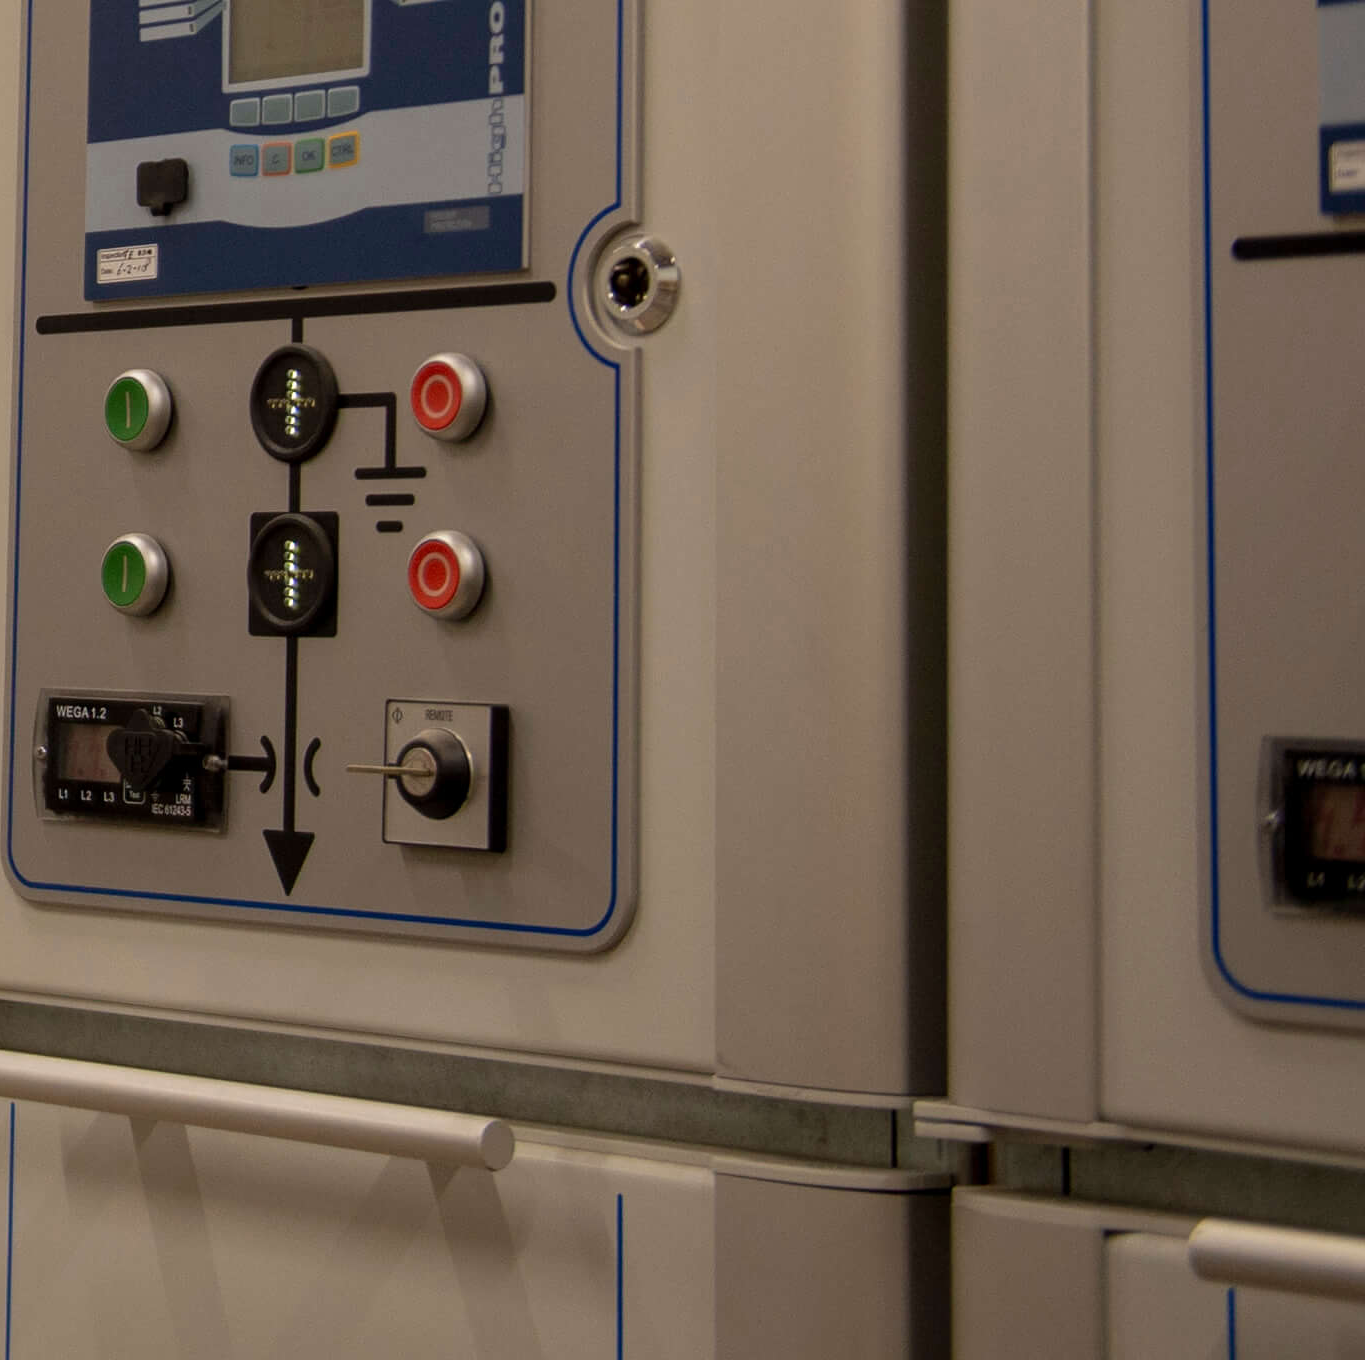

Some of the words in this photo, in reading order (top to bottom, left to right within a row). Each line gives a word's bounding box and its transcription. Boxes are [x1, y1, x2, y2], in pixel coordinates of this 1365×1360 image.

[57, 705, 89, 719] WEGA
[92, 707, 107, 720] 1.2
[153, 705, 163, 716] L2
[173, 717, 185, 729] L3
[1297, 759, 1357, 778] WEGA
[58, 788, 69, 800] L1
[80, 790, 93, 801] L2
[103, 791, 116, 803] L3
[175, 793, 192, 805] LRM
